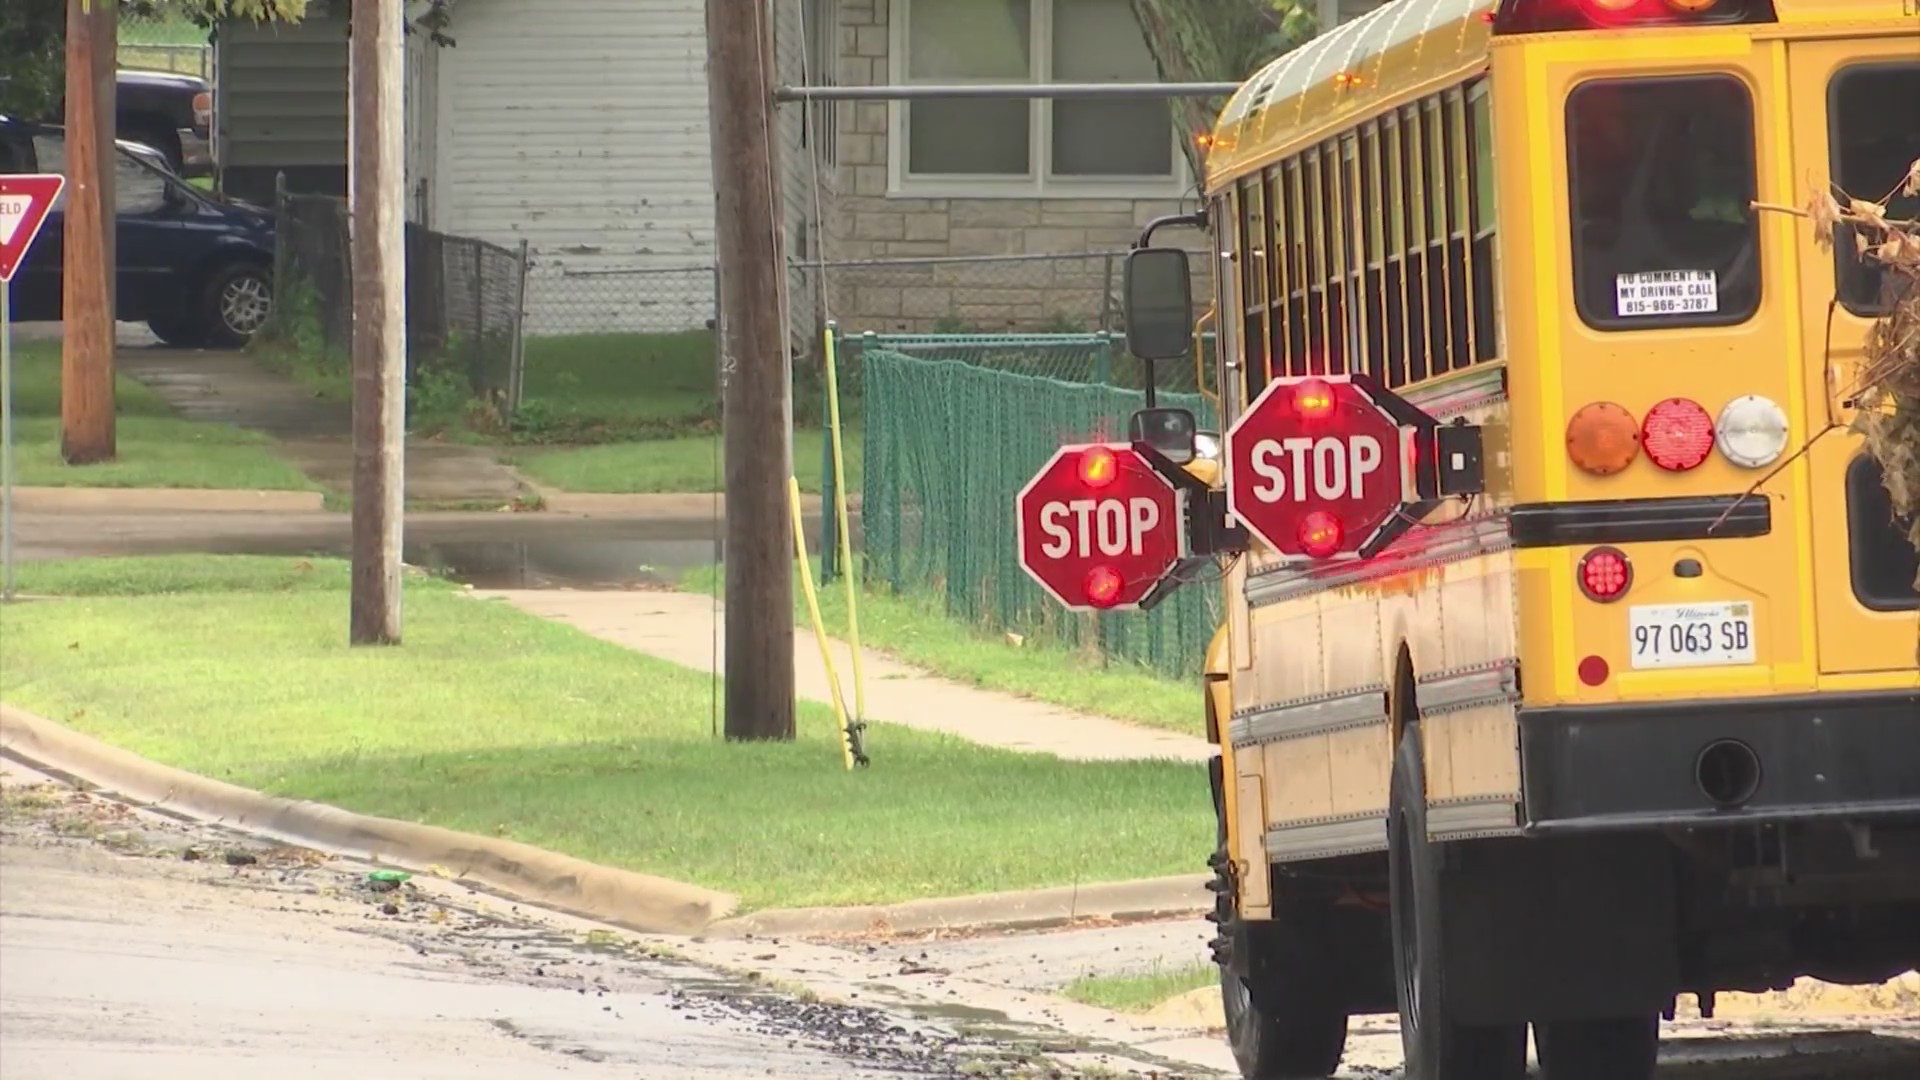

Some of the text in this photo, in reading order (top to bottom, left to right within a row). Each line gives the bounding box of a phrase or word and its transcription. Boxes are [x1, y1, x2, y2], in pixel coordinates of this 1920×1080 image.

[1640, 271, 1692, 283] COMMENT
[1697, 271, 1711, 280] ON
[1620, 284, 1713, 298] MY DRIVING CALL
[1626, 298, 1709, 313] 815-966-3787
[1250, 434, 1382, 503] STOP
[1040, 497, 1160, 560] STOP
[1635, 620, 1749, 655] 97 063 SB
